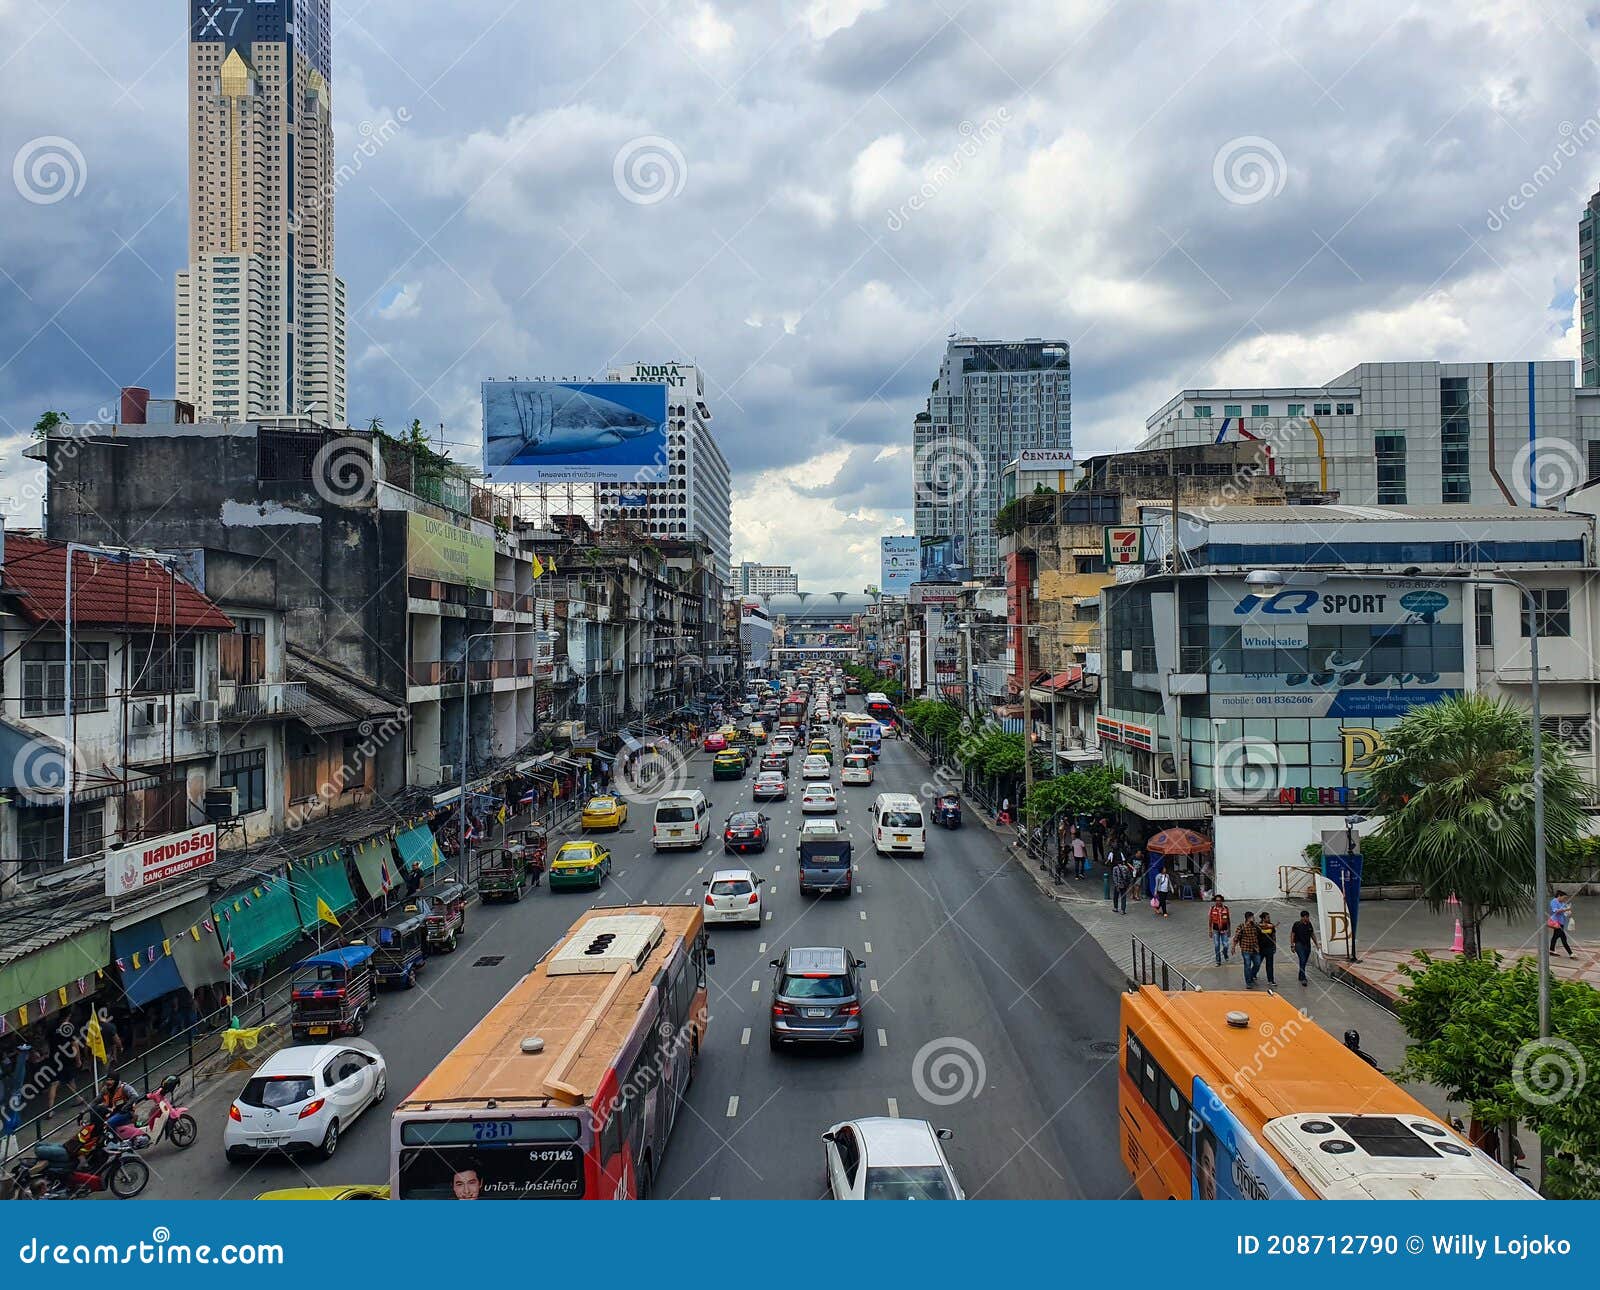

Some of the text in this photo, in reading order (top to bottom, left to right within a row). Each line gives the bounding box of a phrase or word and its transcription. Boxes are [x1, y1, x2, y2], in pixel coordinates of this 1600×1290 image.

[200, 7, 244, 36] X7
[636, 366, 679, 376] INDRA
[1022, 450, 1071, 461] CENTARA
[425, 519, 484, 549] LONG LIVE THE KING
[1323, 594, 1386, 613] SPORT
[1244, 637, 1302, 646] Wholesaler
[1222, 696, 1250, 705] mobile
[1256, 696, 1271, 704] 081
[1275, 696, 1313, 704] 8362606
[1279, 787, 1349, 805] NIGHT
[143, 832, 214, 867] แสงเจริญ
[144, 870, 162, 882] SANG
[530, 1150, 574, 1162] 8-67142
